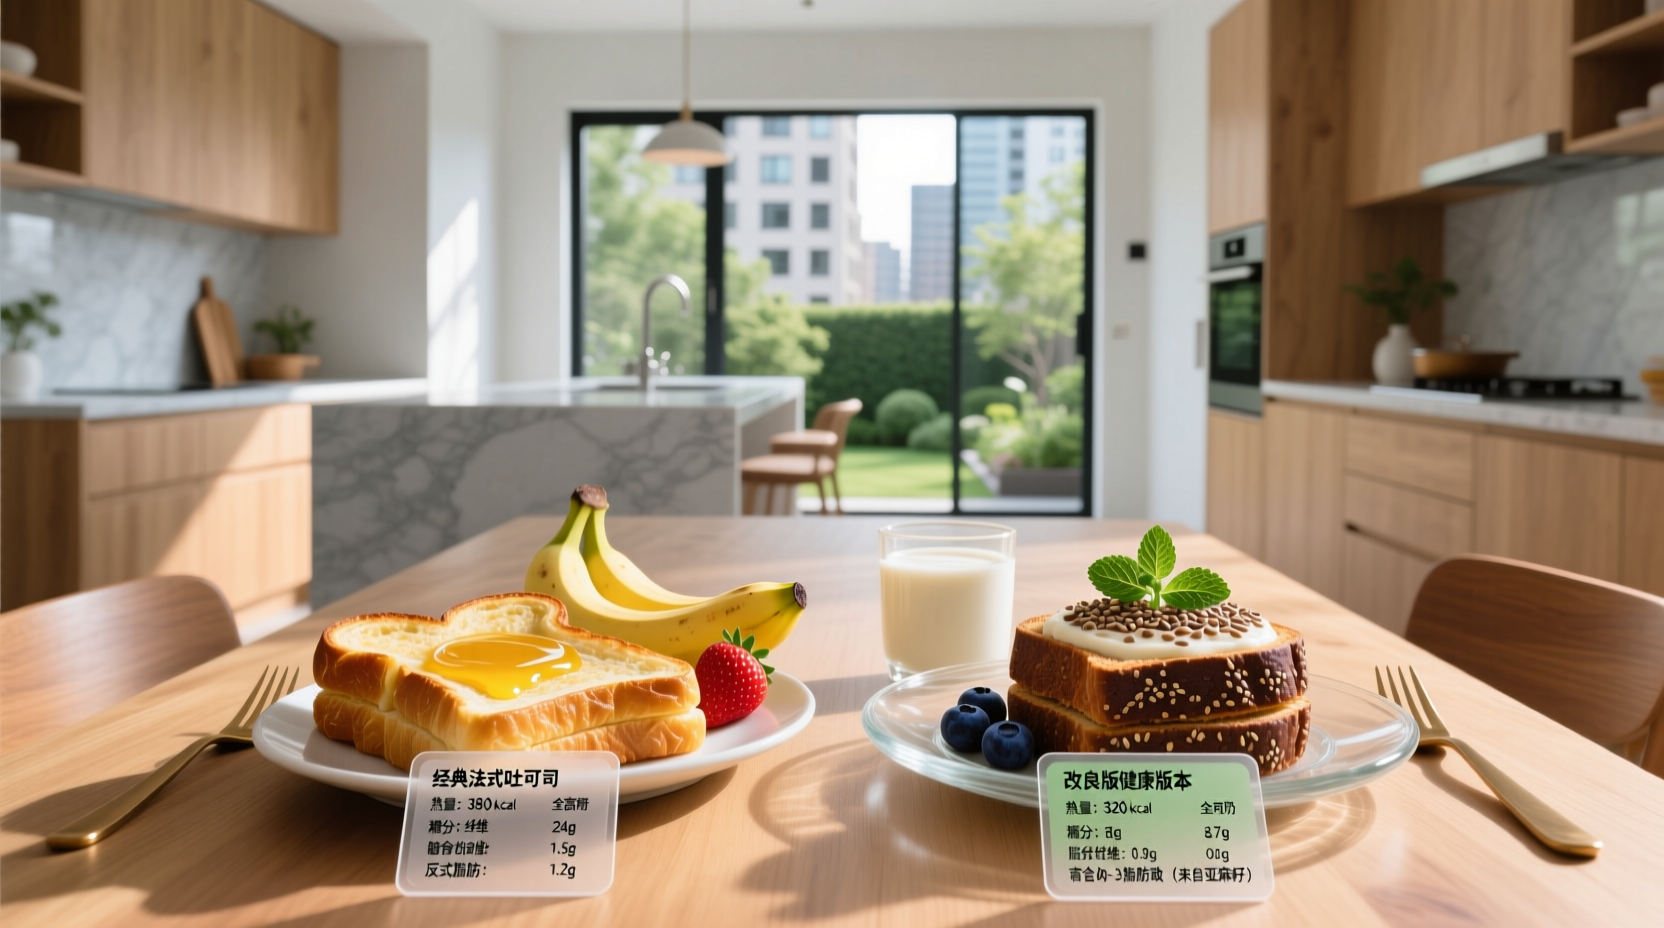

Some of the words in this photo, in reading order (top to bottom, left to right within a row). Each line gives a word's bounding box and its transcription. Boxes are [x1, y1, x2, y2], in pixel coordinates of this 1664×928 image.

[1063, 770, 1192, 791] 改良版健康版本
[1104, 801, 1127, 814] 320
[552, 821, 576, 836] 24g
[551, 842, 576, 857] 1.5g
[550, 863, 576, 879] 1.2g
